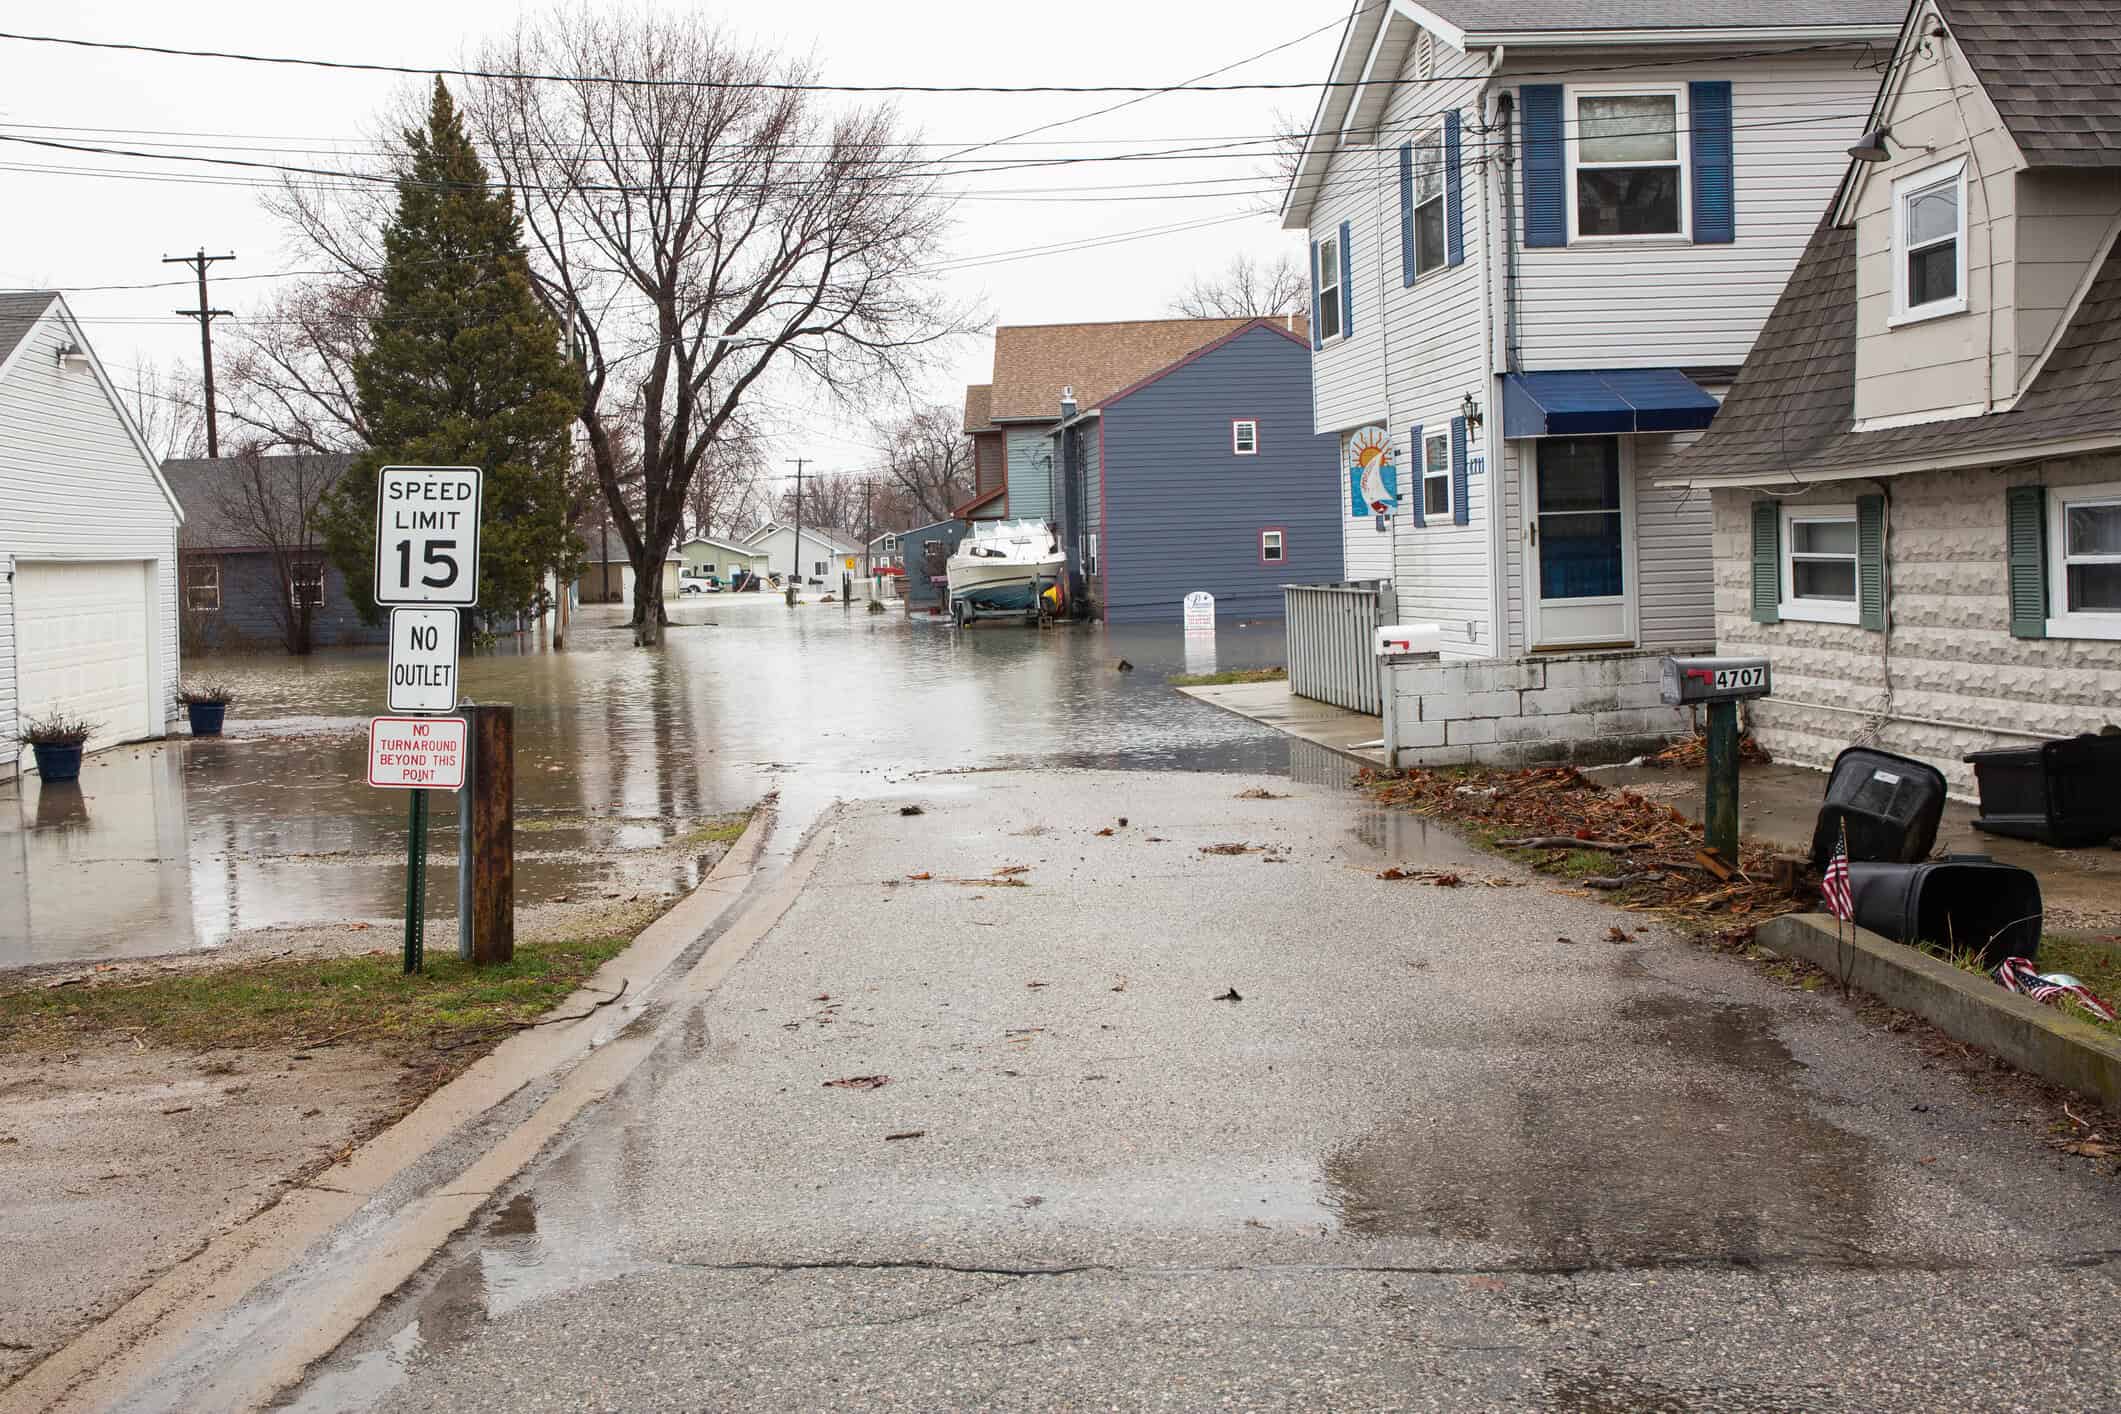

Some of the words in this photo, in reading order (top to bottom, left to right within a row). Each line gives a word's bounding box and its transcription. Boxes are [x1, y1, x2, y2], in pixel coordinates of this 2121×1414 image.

[389, 482, 471, 500] SPEED
[396, 511, 460, 530] LIMIT
[396, 540, 459, 589] 15
[411, 626, 438, 651] NO
[394, 664, 452, 687] OUTLET
[1717, 668, 1763, 687] 4707
[413, 724, 430, 737] NO
[380, 740, 457, 752] TURNAROUND
[380, 754, 426, 766] BEYOND
[433, 755, 456, 767] THIS
[403, 769, 436, 781] POINT
